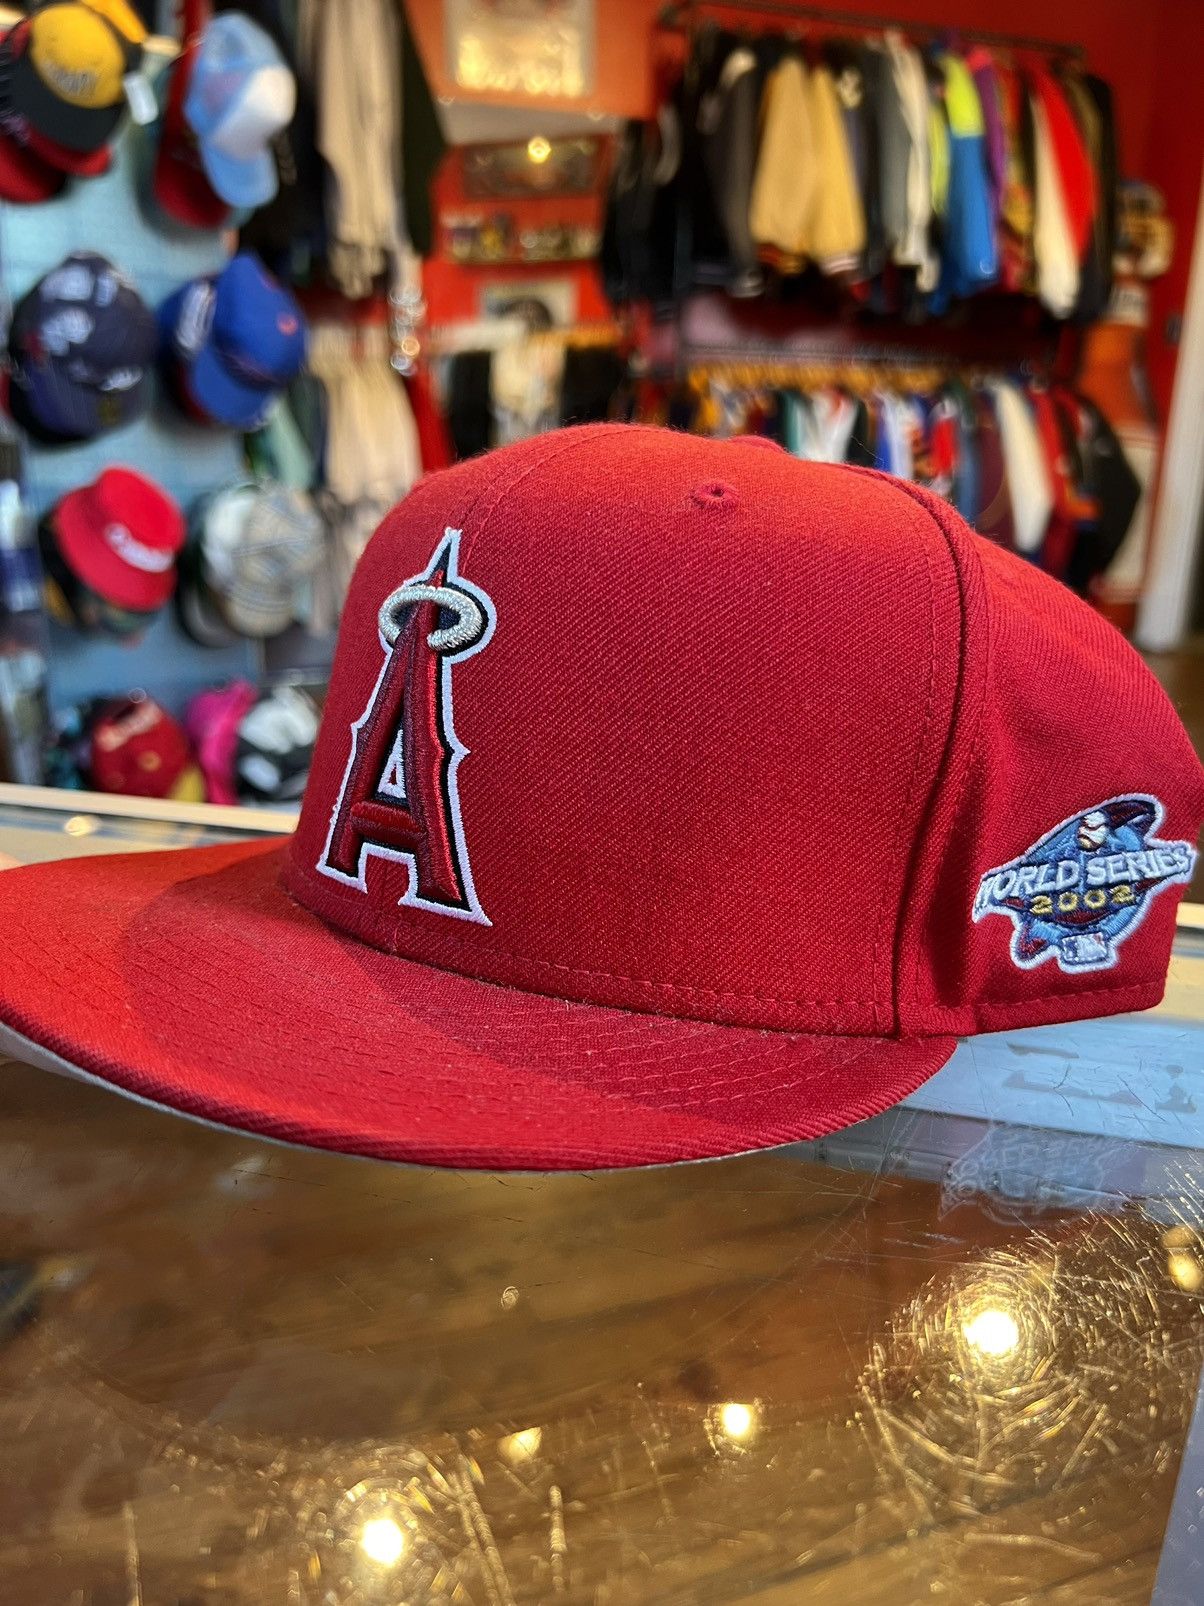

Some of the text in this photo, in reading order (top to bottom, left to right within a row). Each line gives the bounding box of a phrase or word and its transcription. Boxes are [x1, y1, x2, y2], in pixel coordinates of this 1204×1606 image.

[317, 527, 495, 926] A
[1086, 848, 1191, 886] SERIES
[1031, 886, 1136, 914] 2002
